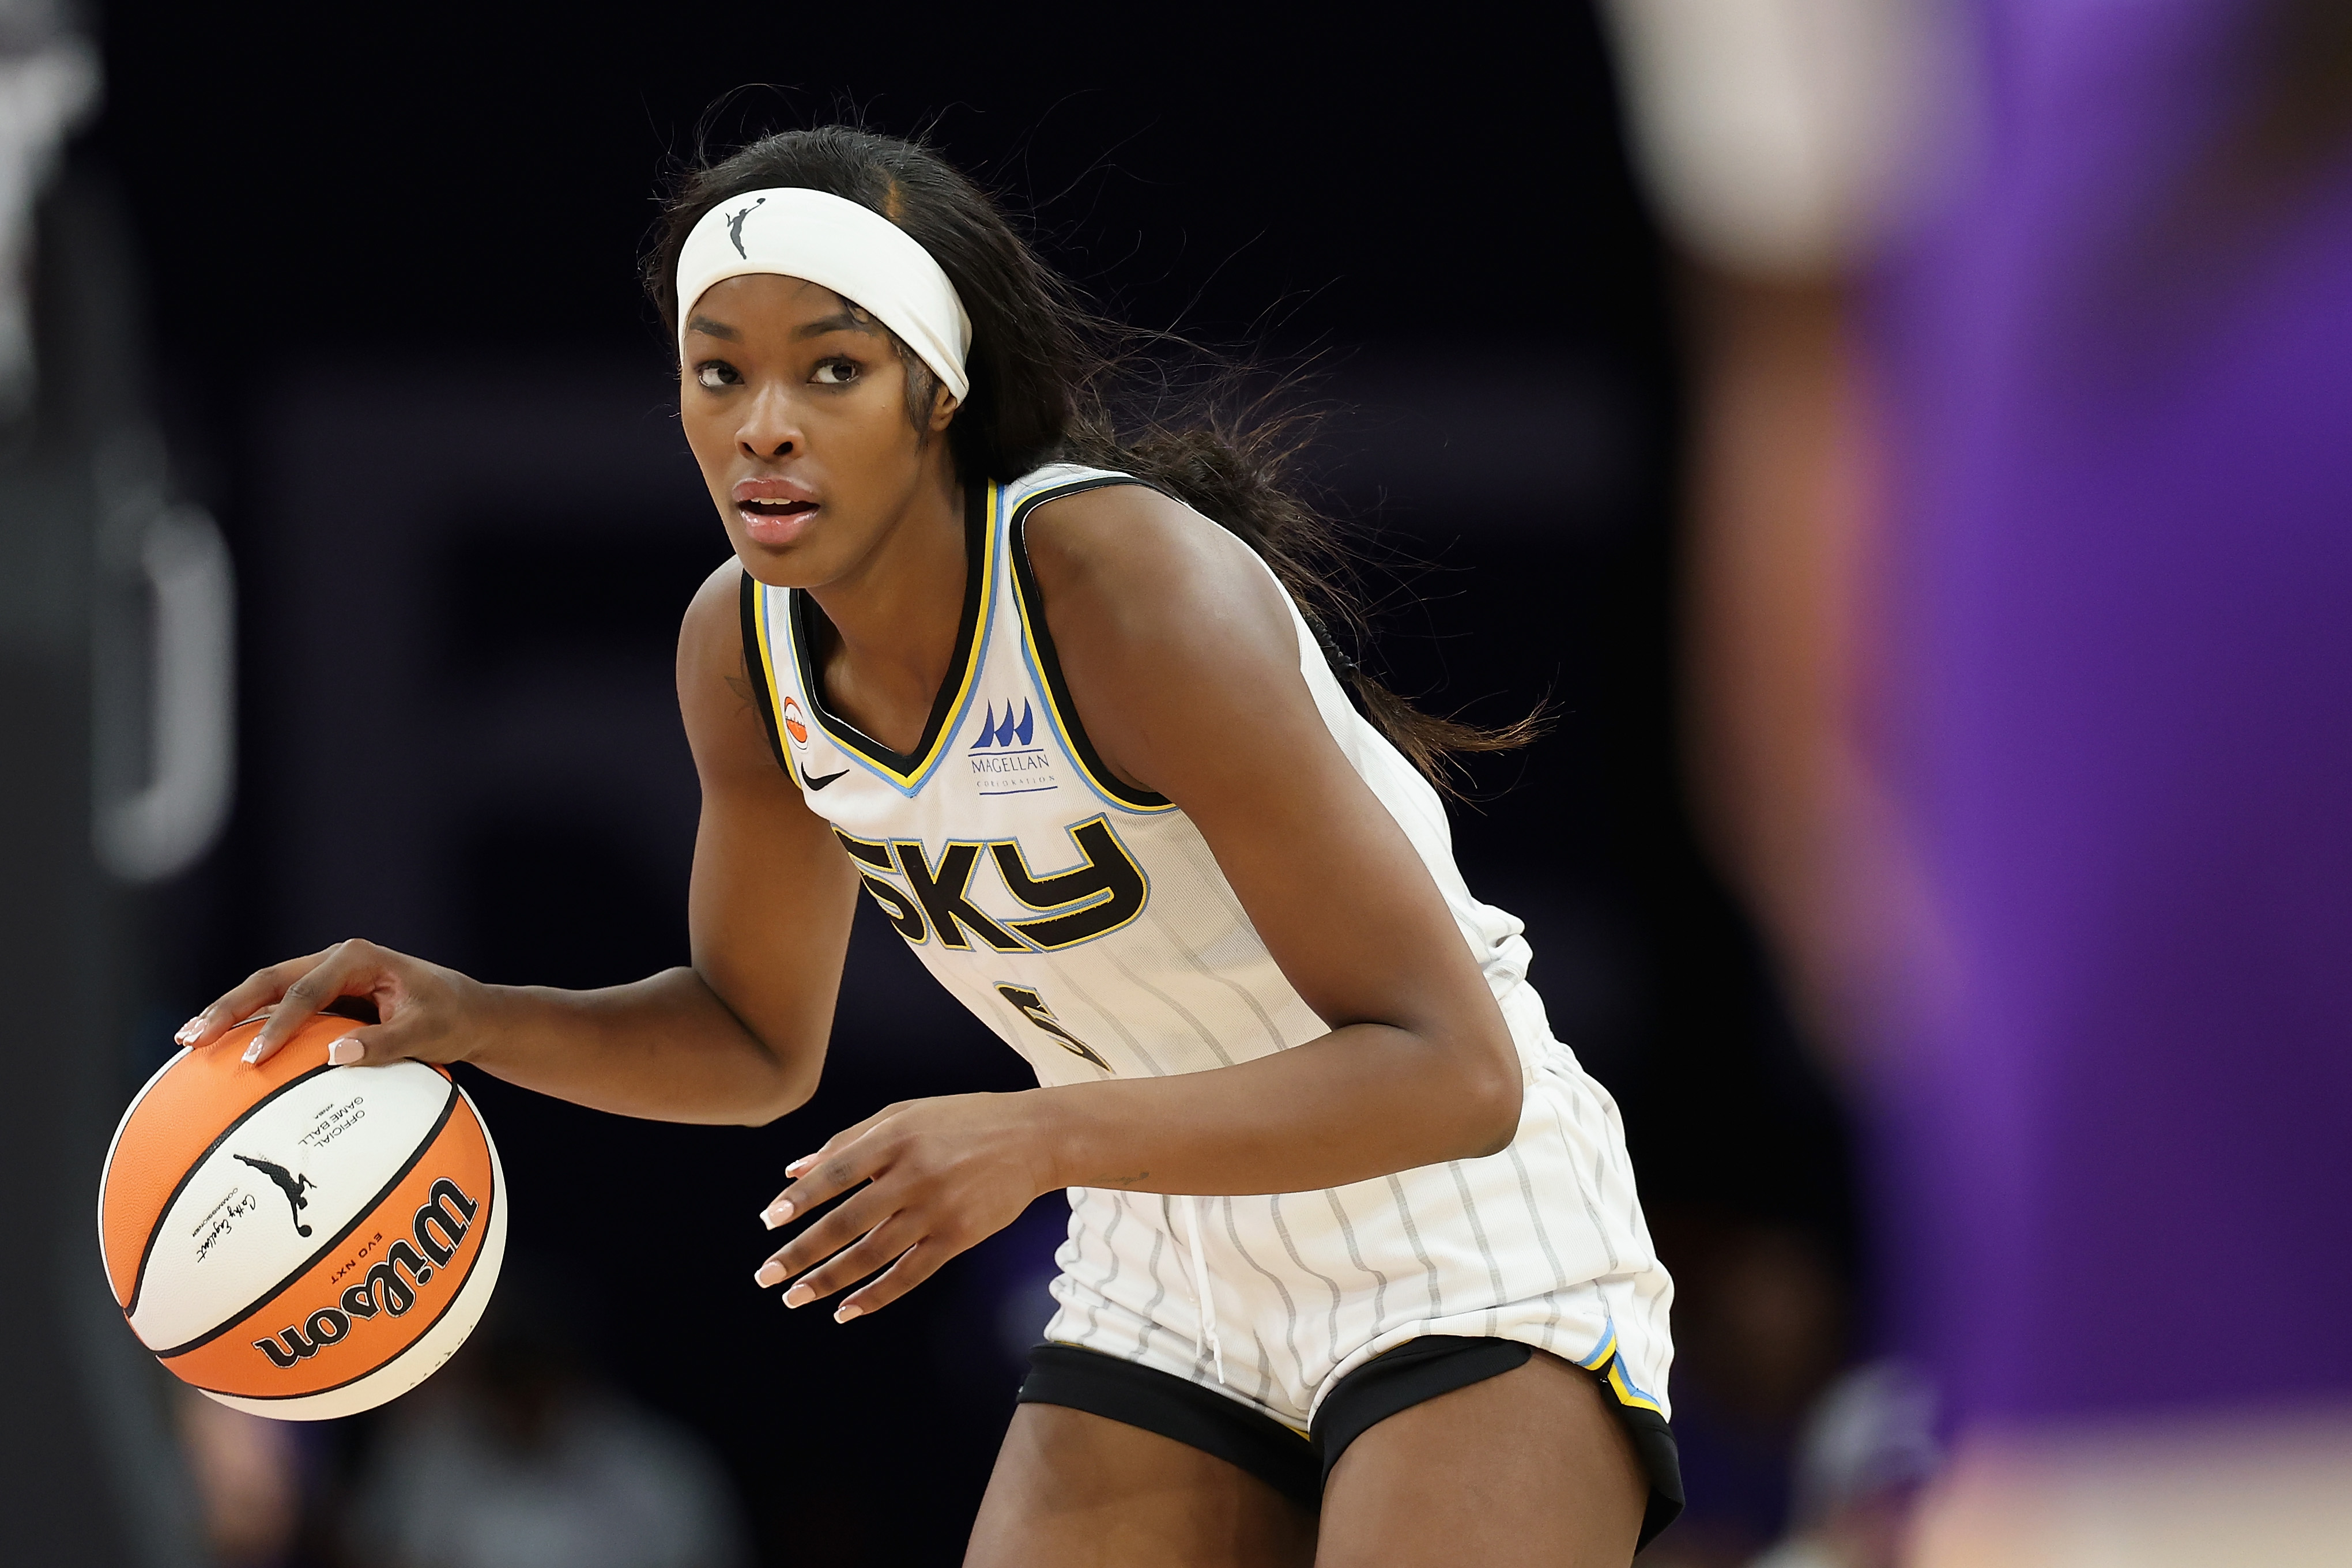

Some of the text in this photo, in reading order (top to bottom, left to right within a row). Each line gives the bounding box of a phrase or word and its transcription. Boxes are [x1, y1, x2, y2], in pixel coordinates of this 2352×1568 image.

[971, 754, 1049, 774] MAGELLAN
[831, 812, 1151, 954] SKY
[297, 1096, 363, 1145] GAME BALL
[314, 1110, 365, 1147] OFFICIAL
[251, 1177, 479, 1369] Wilson
[331, 1232, 383, 1284] EVO NXT
